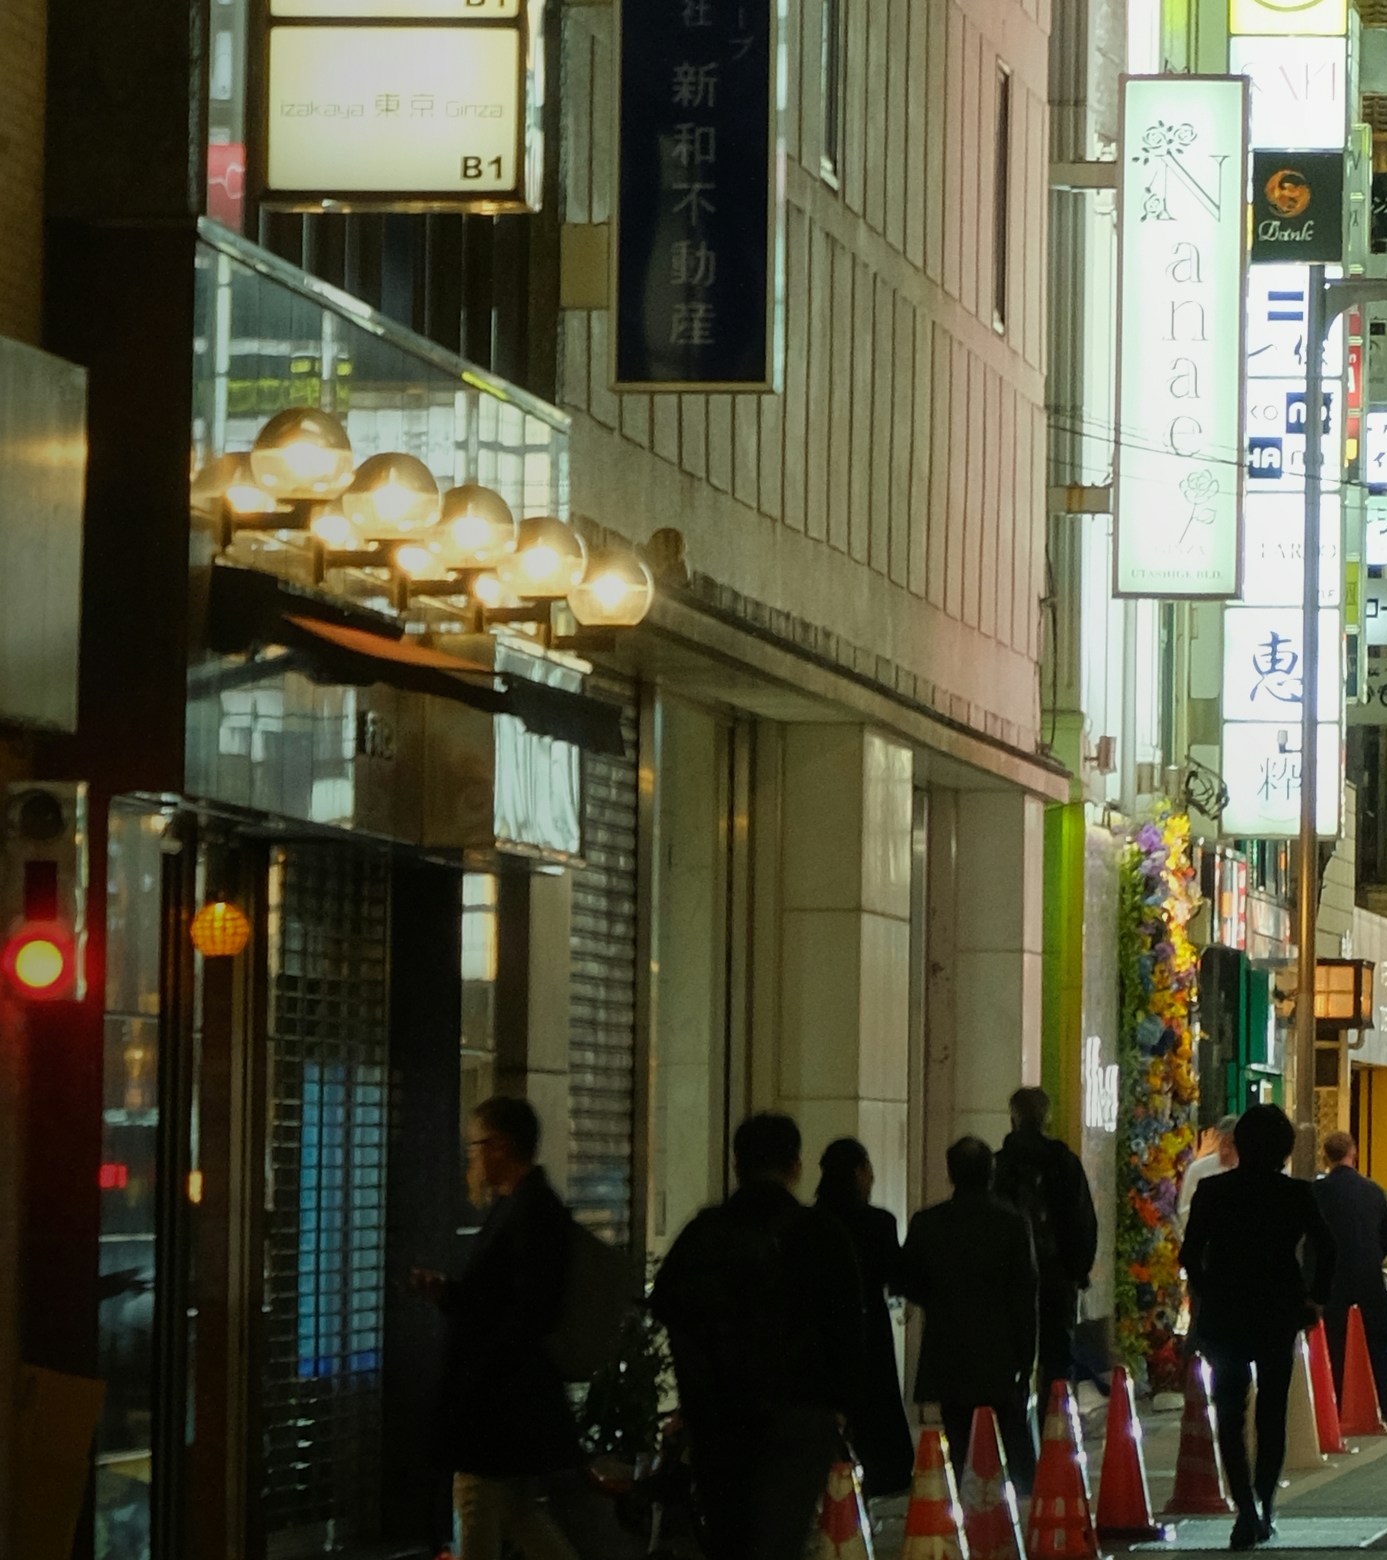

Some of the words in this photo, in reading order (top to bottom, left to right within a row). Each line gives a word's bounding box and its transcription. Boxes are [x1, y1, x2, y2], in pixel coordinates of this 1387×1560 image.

[374, 92, 435, 117] 東京
[445, 99, 504, 118] Ginza
[460, 155, 505, 180] B1
[670, 62, 717, 347] 新和不動産
